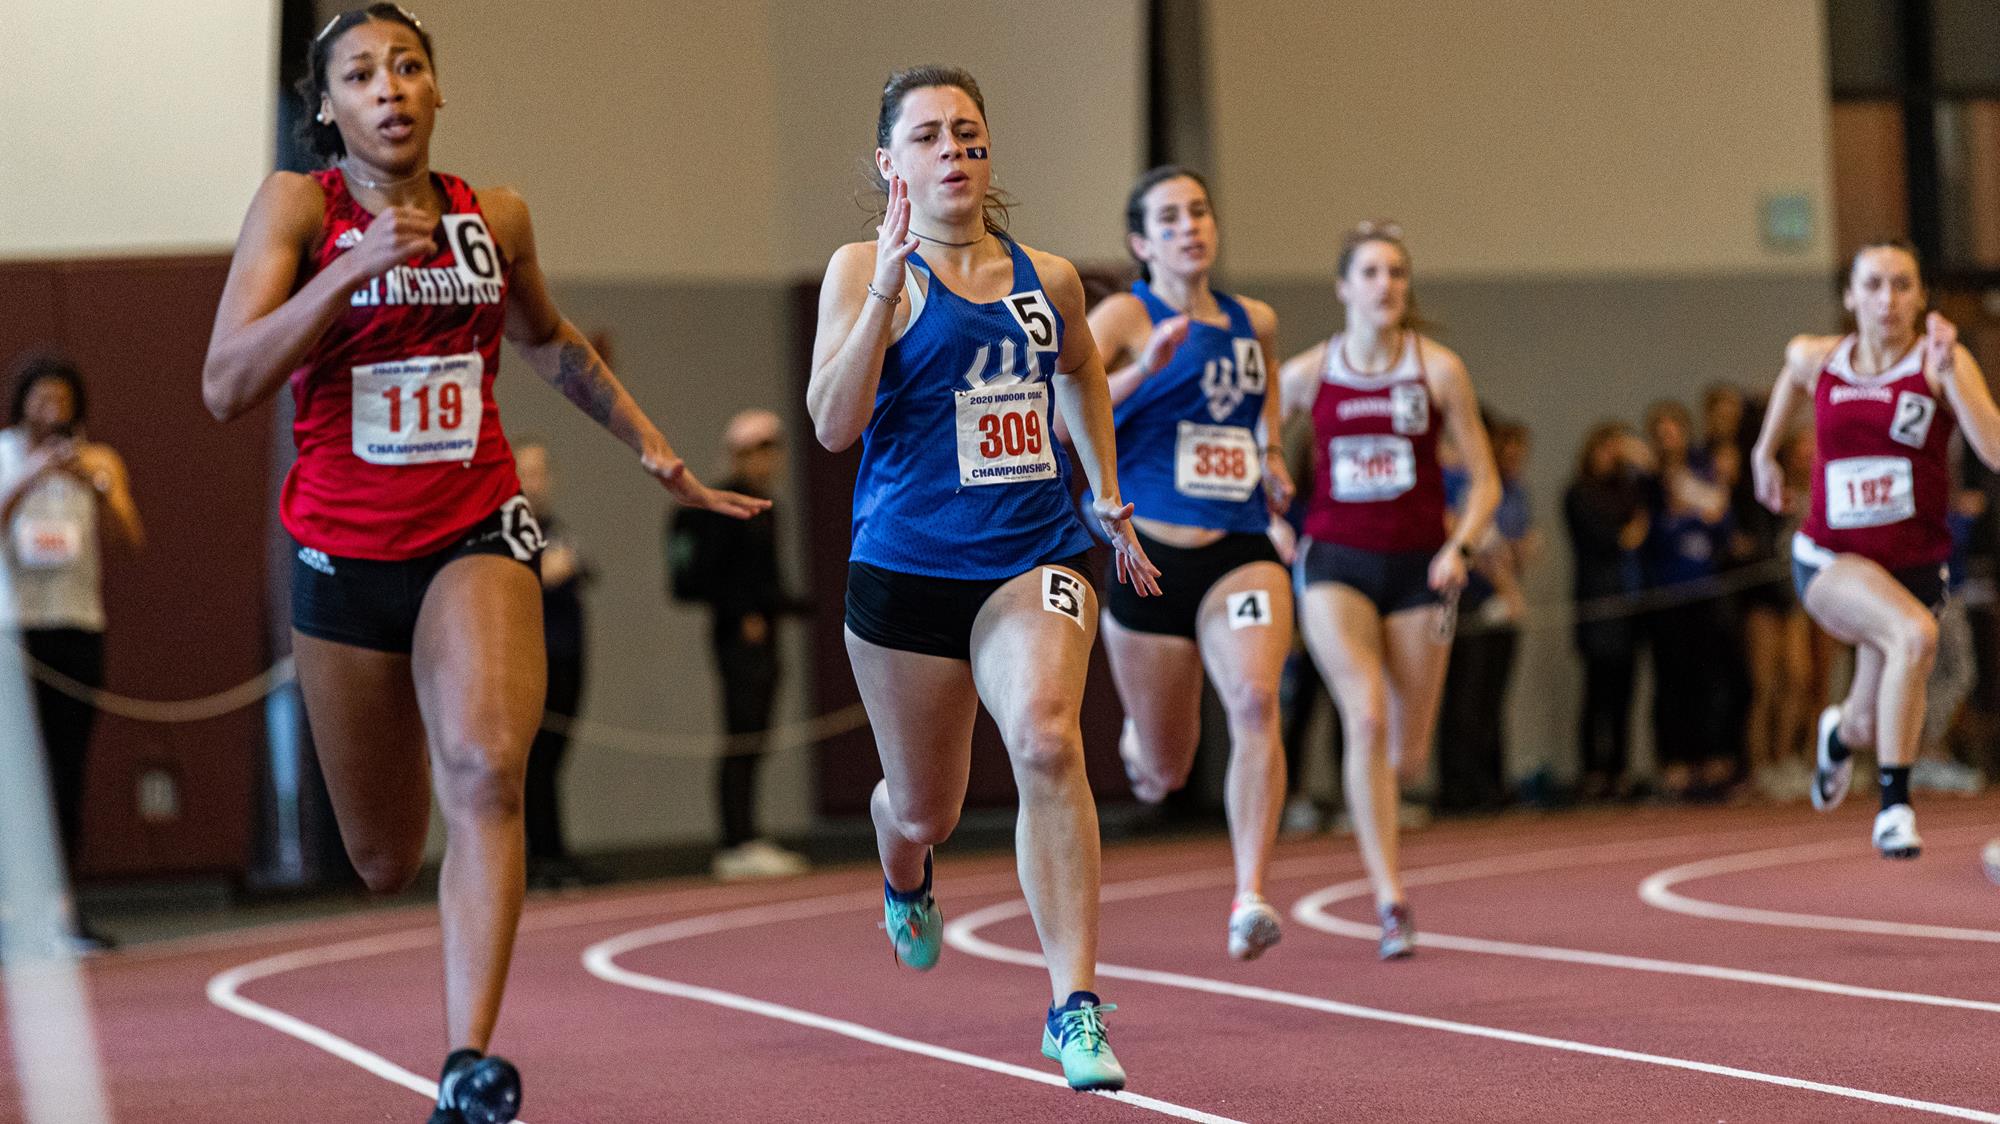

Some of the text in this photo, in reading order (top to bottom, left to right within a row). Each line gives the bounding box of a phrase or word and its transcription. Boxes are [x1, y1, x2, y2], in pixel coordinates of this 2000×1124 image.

[457, 219, 495, 279] 6
[1011, 296, 1053, 346] 5
[1244, 347, 1261, 387] 4
[382, 382, 462, 432] 119
[970, 395, 993, 405] 2020
[994, 392, 1026, 403] INDOOR
[1899, 401, 1926, 436] 2
[978, 410, 1042, 459] 309
[971, 462, 1051, 479] CHAMPIONSHIPS
[1194, 443, 1246, 481] 338
[512, 503, 538, 553] 6
[1048, 573, 1080, 618] 5
[1236, 595, 1263, 622] 4
